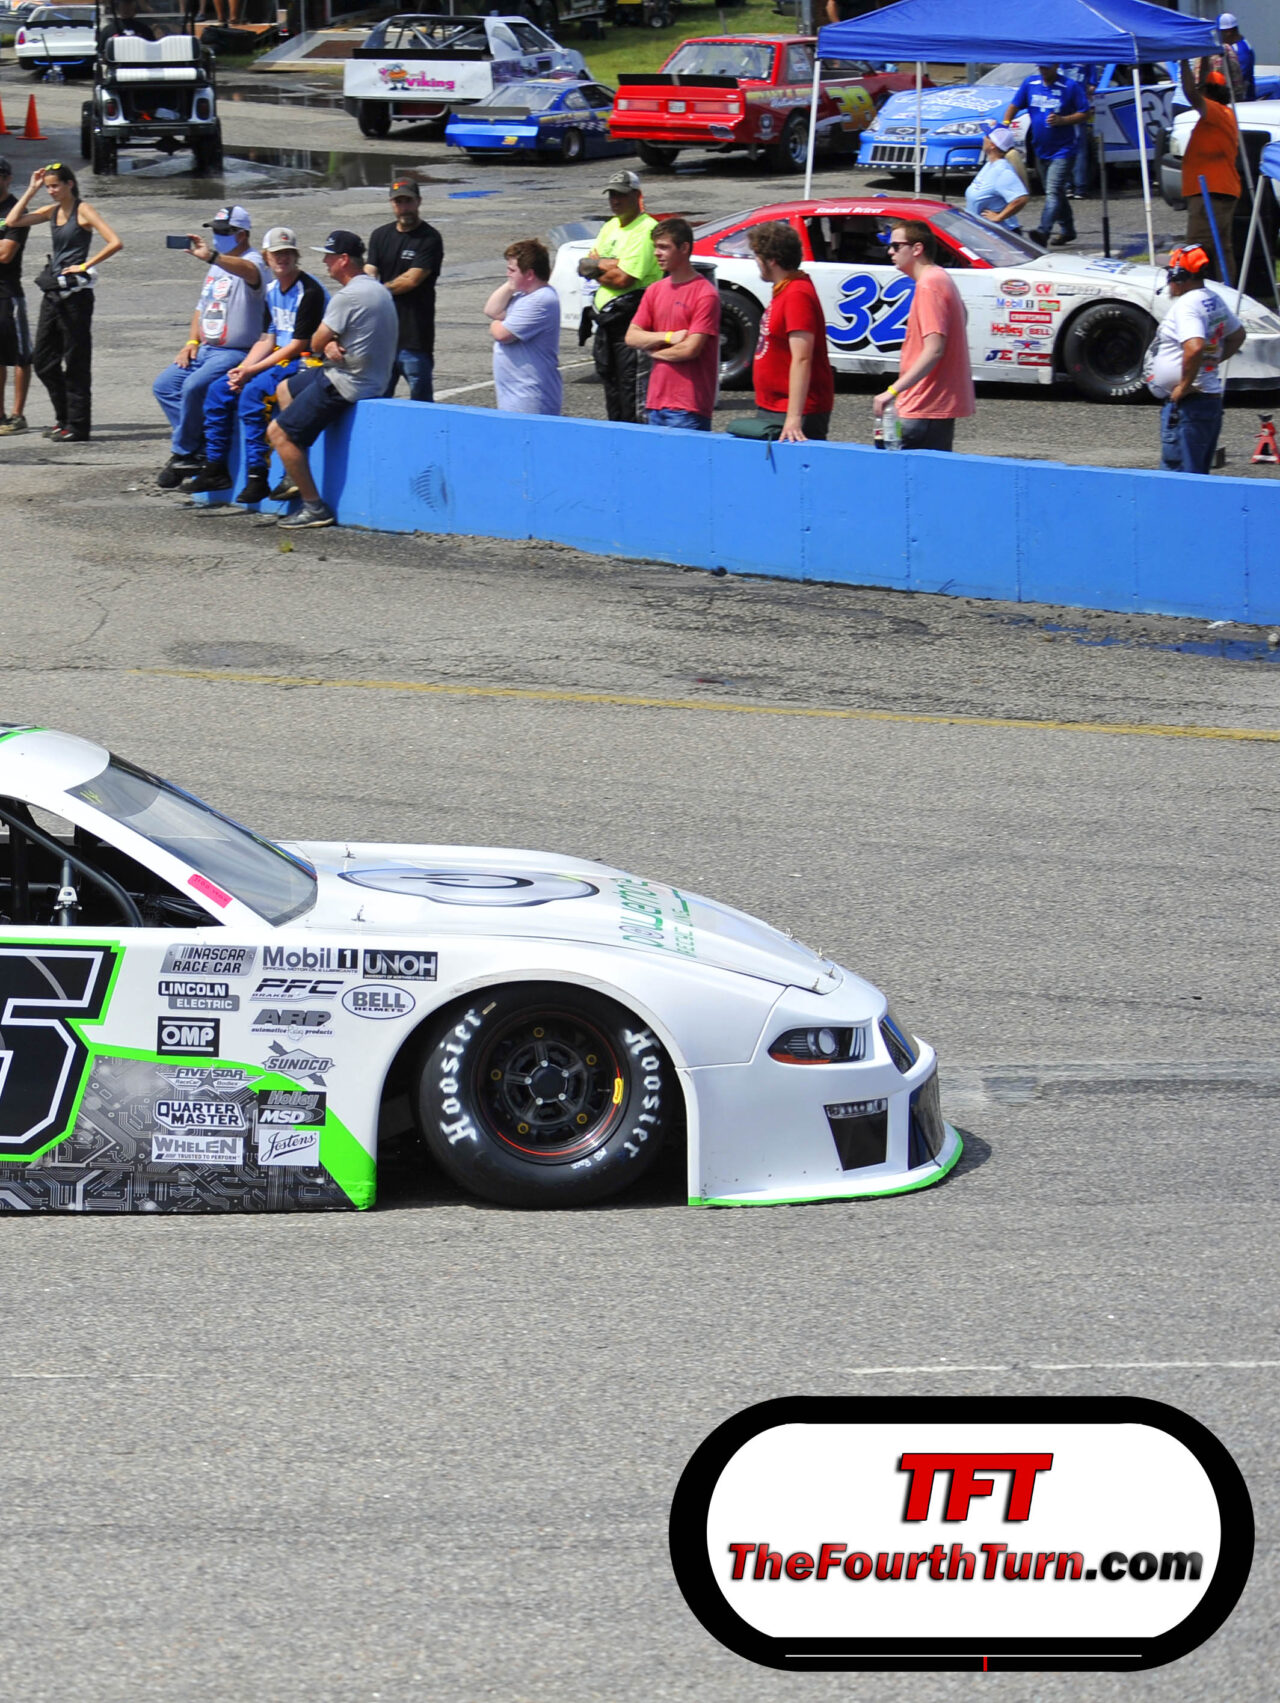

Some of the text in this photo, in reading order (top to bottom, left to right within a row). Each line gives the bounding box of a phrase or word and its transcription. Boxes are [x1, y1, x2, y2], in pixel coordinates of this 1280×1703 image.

[405, 71, 455, 90] Viking
[851, 206, 885, 214] Driver
[1035, 283, 1052, 294] CV
[996, 298, 1023, 308] Mobil
[826, 272, 917, 352] 32
[991, 323, 1024, 337] Holley
[1029, 327, 1051, 336] BELL
[194, 947, 246, 961] NASCAR
[262, 946, 331, 969] Mobil
[172, 960, 242, 974] RACE CAR
[365, 951, 436, 976] UNOH
[161, 982, 227, 997] LINCOLN
[254, 977, 345, 995] PFC
[176, 998, 233, 1010] ELECTRIC
[352, 991, 407, 1009] BELL
[252, 1008, 332, 1027] ARP
[161, 1026, 215, 1047] OMP
[304, 1028, 333, 1036] products
[269, 1057, 330, 1072] SUNOCO
[175, 1068, 244, 1080] FIVE STAR
[439, 1007, 482, 1146] Hoosier
[622, 1024, 661, 1158] Hoosier
[269, 1091, 320, 1108] Holley
[157, 1101, 236, 1118] QUARTER
[170, 1113, 240, 1126] MASTER
[260, 1110, 308, 1125] MSD
[260, 1131, 318, 1163] Jostens
[210, 1153, 237, 1161] PERFORM
